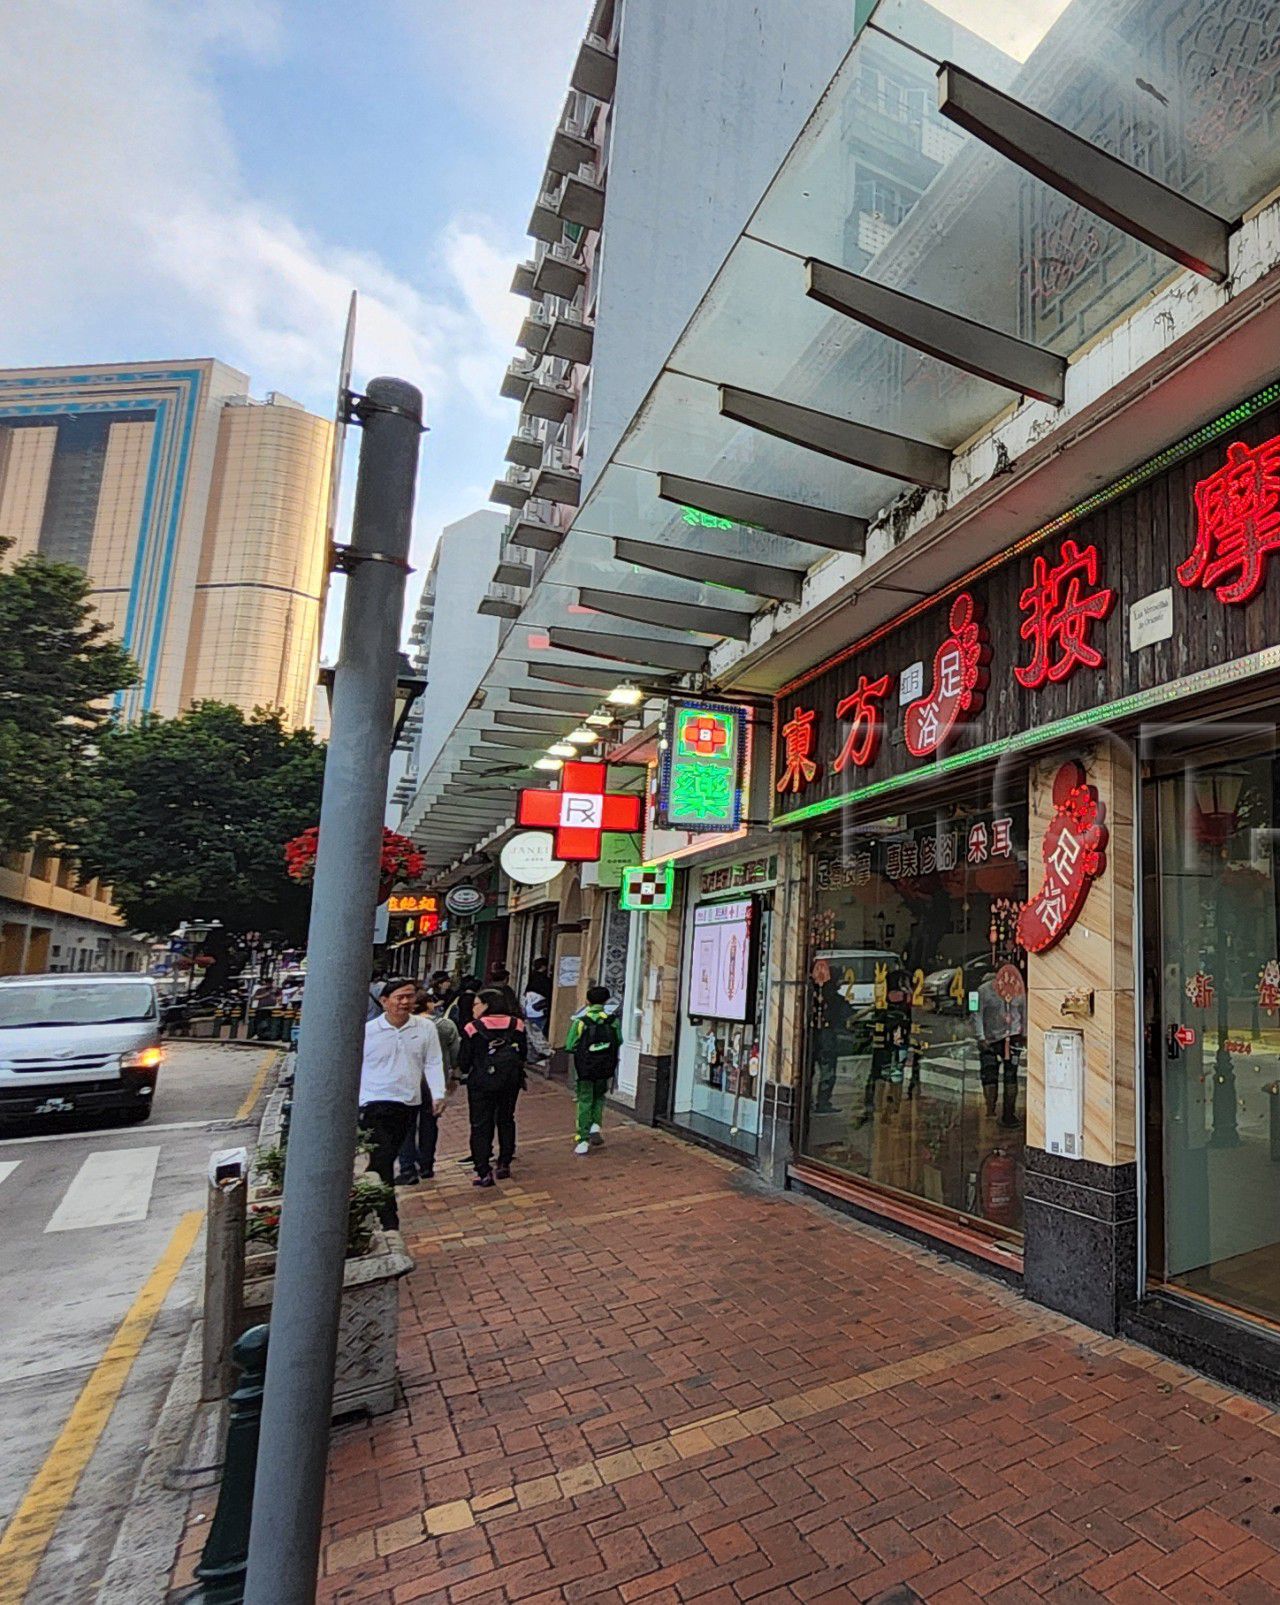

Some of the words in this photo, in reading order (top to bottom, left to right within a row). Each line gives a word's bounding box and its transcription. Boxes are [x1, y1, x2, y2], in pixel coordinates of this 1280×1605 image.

[776, 674, 892, 794] 東方
[915, 649, 960, 750] 足浴
[566, 797, 595, 823] Rx
[672, 761, 732, 819] 藥
[967, 817, 1013, 864] 采耳
[1035, 827, 1082, 932] 足浴
